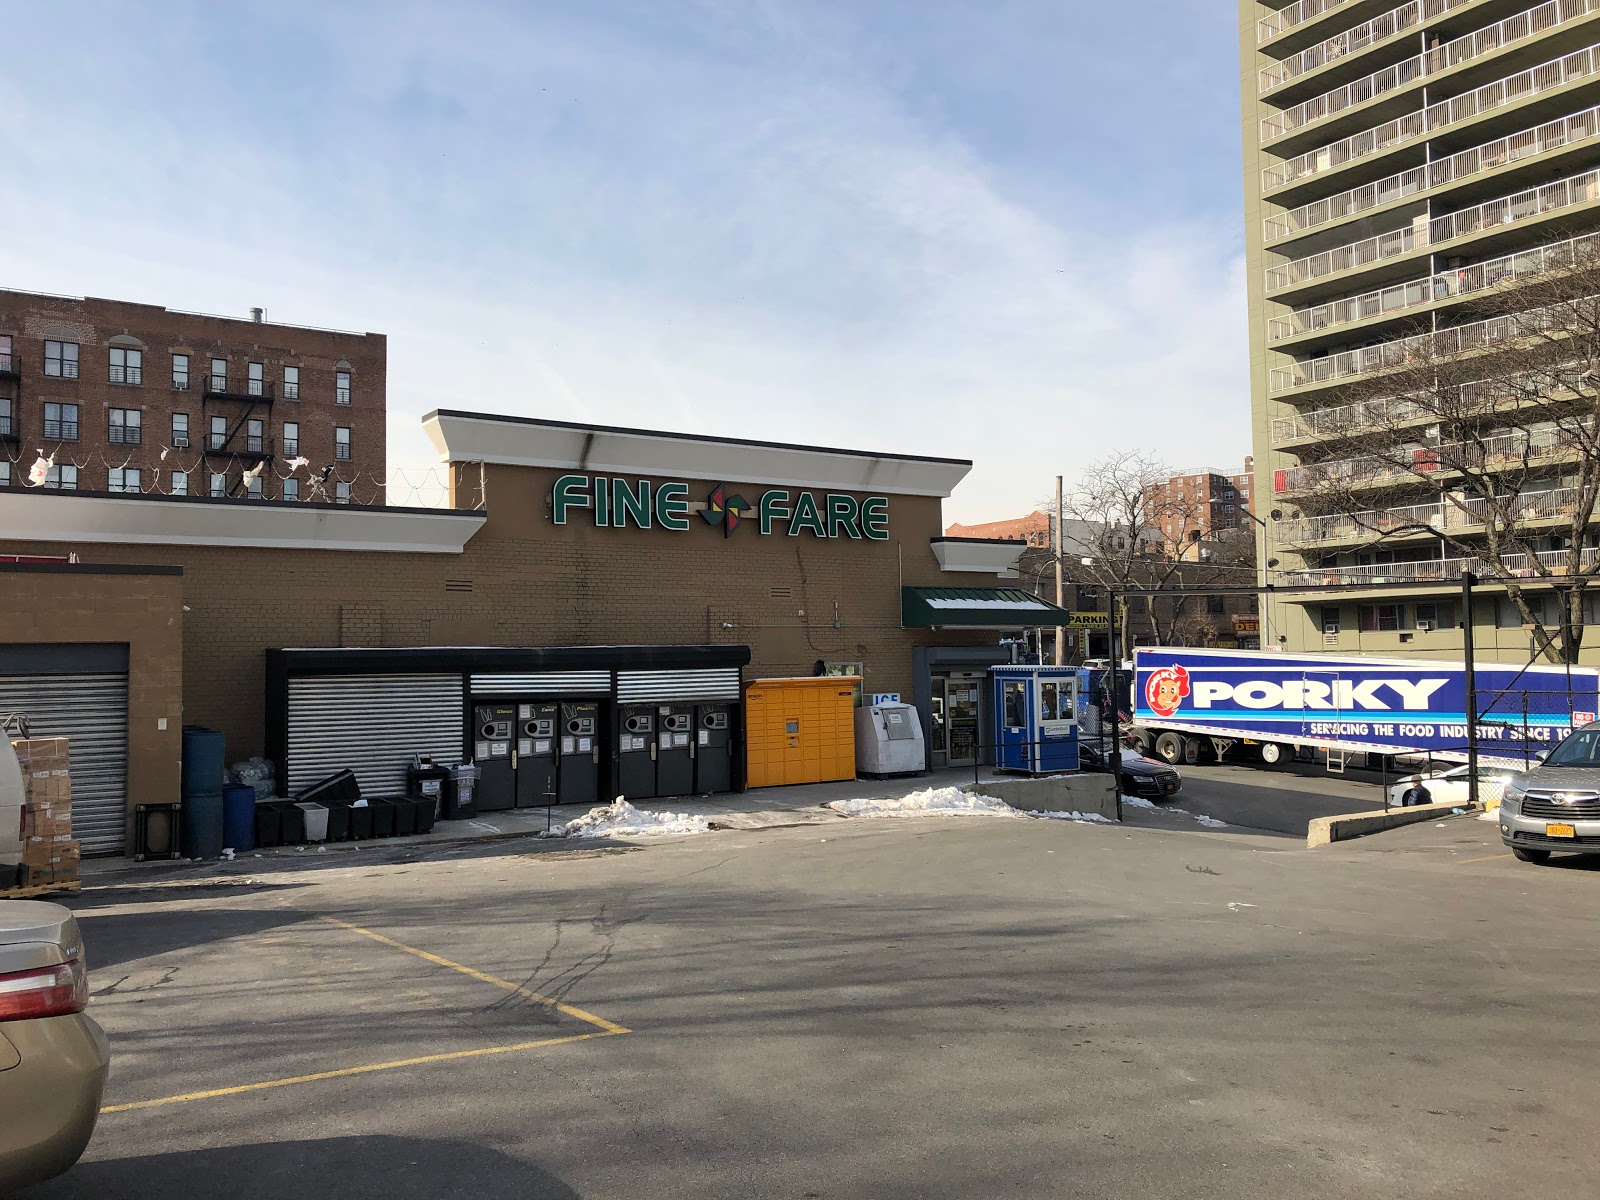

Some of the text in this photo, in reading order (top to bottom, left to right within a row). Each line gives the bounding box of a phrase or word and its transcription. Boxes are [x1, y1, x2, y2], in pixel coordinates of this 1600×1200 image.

[553, 474, 890, 541] FINE FARE
[1068, 615, 1119, 624] PARKING
[1149, 671, 1178, 703] PORKY
[1192, 678, 1450, 710] PORKY
[1310, 722, 1369, 736] SERVICING
[1373, 724, 1394, 736] THE
[1400, 724, 1435, 738] FOOD
[1440, 725, 1505, 739] INDUSTRY
[1510, 727, 1551, 741] SINCE
